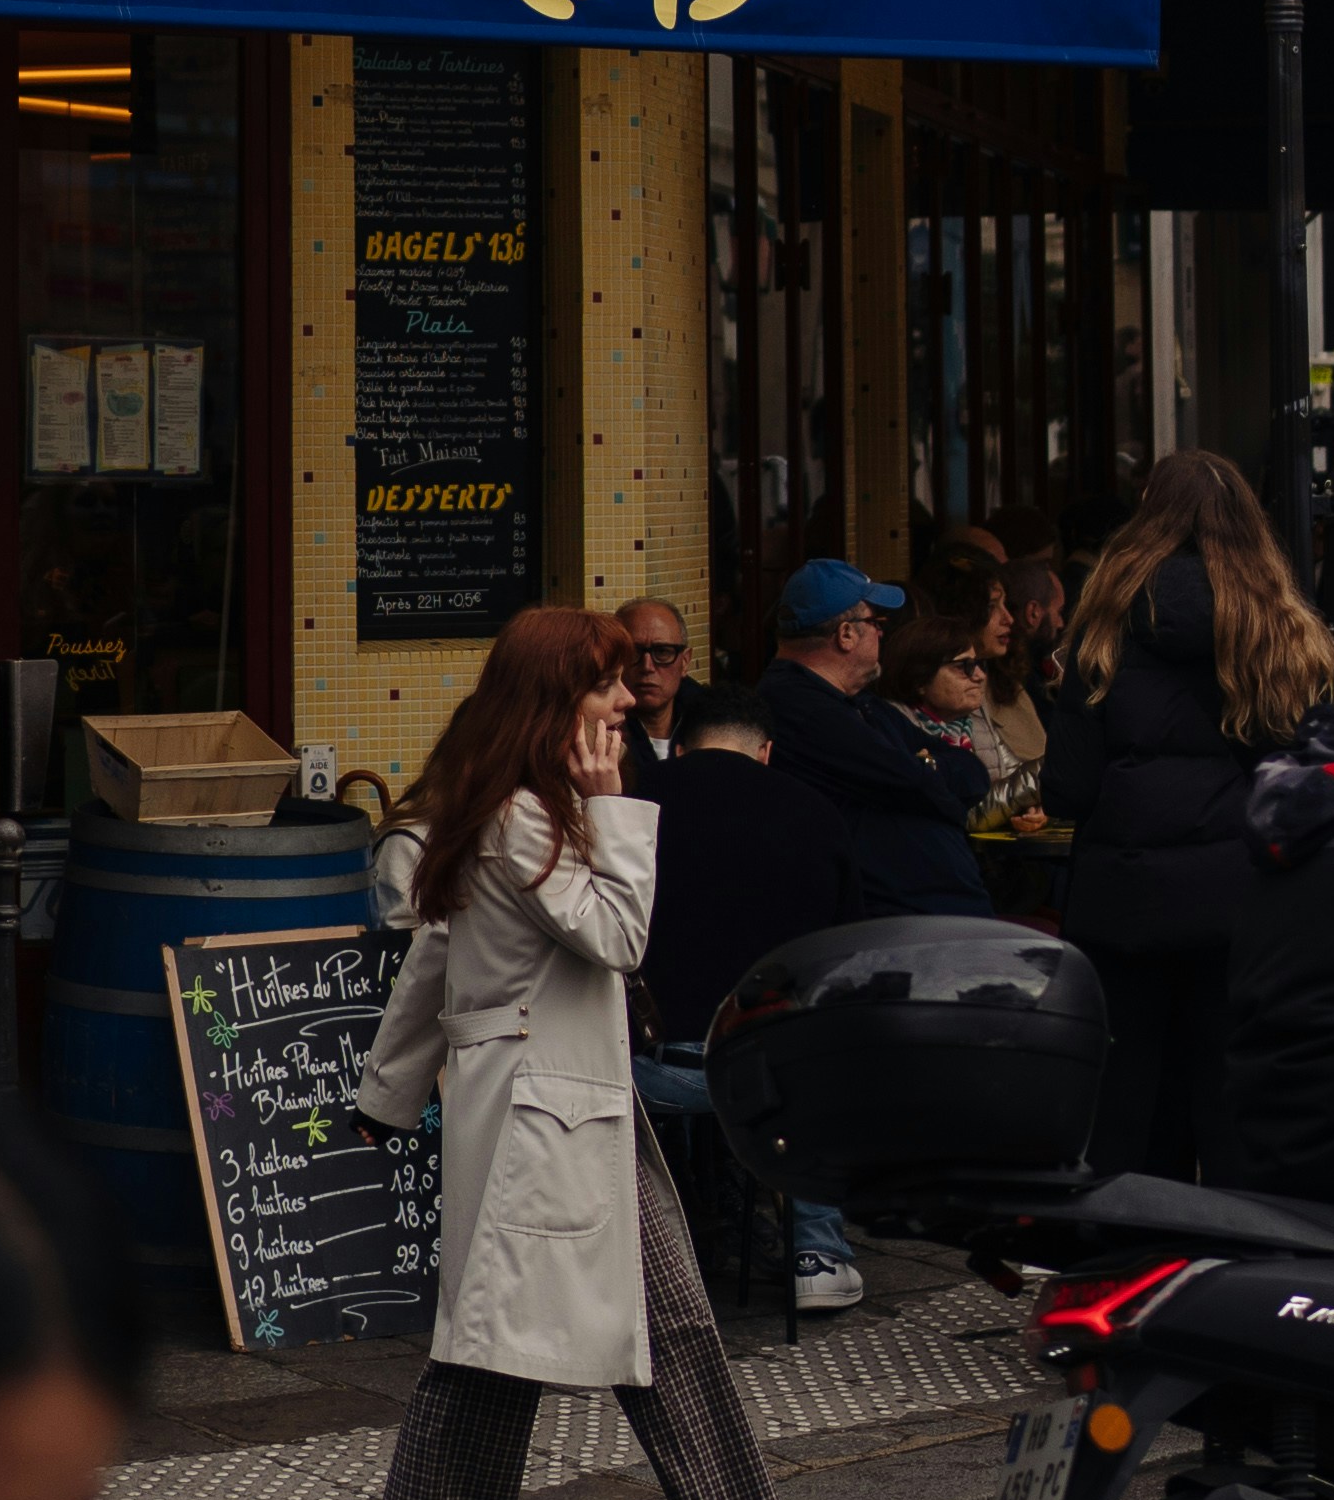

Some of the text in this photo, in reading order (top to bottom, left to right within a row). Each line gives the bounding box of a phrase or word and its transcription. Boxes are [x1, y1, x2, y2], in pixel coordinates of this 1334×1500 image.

[417, 55, 433, 71] et
[438, 50, 505, 73] Tartines
[406, 310, 474, 334] Plats
[367, 482, 514, 512] DESSERTS
[376, 596, 411, 615] Après
[417, 595, 442, 609] 22H
[46, 632, 127, 663] Poussez
[310, 761, 328, 770] AIDE
[312, 962, 331, 1000] du
[282, 1041, 340, 1080] Pleine
[220, 1147, 241, 1189] 3
[246, 1142, 309, 1179] huîtres
[227, 1193, 245, 1225] 6
[250, 1182, 307, 1215] huîtres
[230, 1233, 249, 1270] 9
[254, 1224, 314, 1263] huîtres
[239, 1276, 268, 1314] 12
[271, 1263, 329, 1300] huîtres
